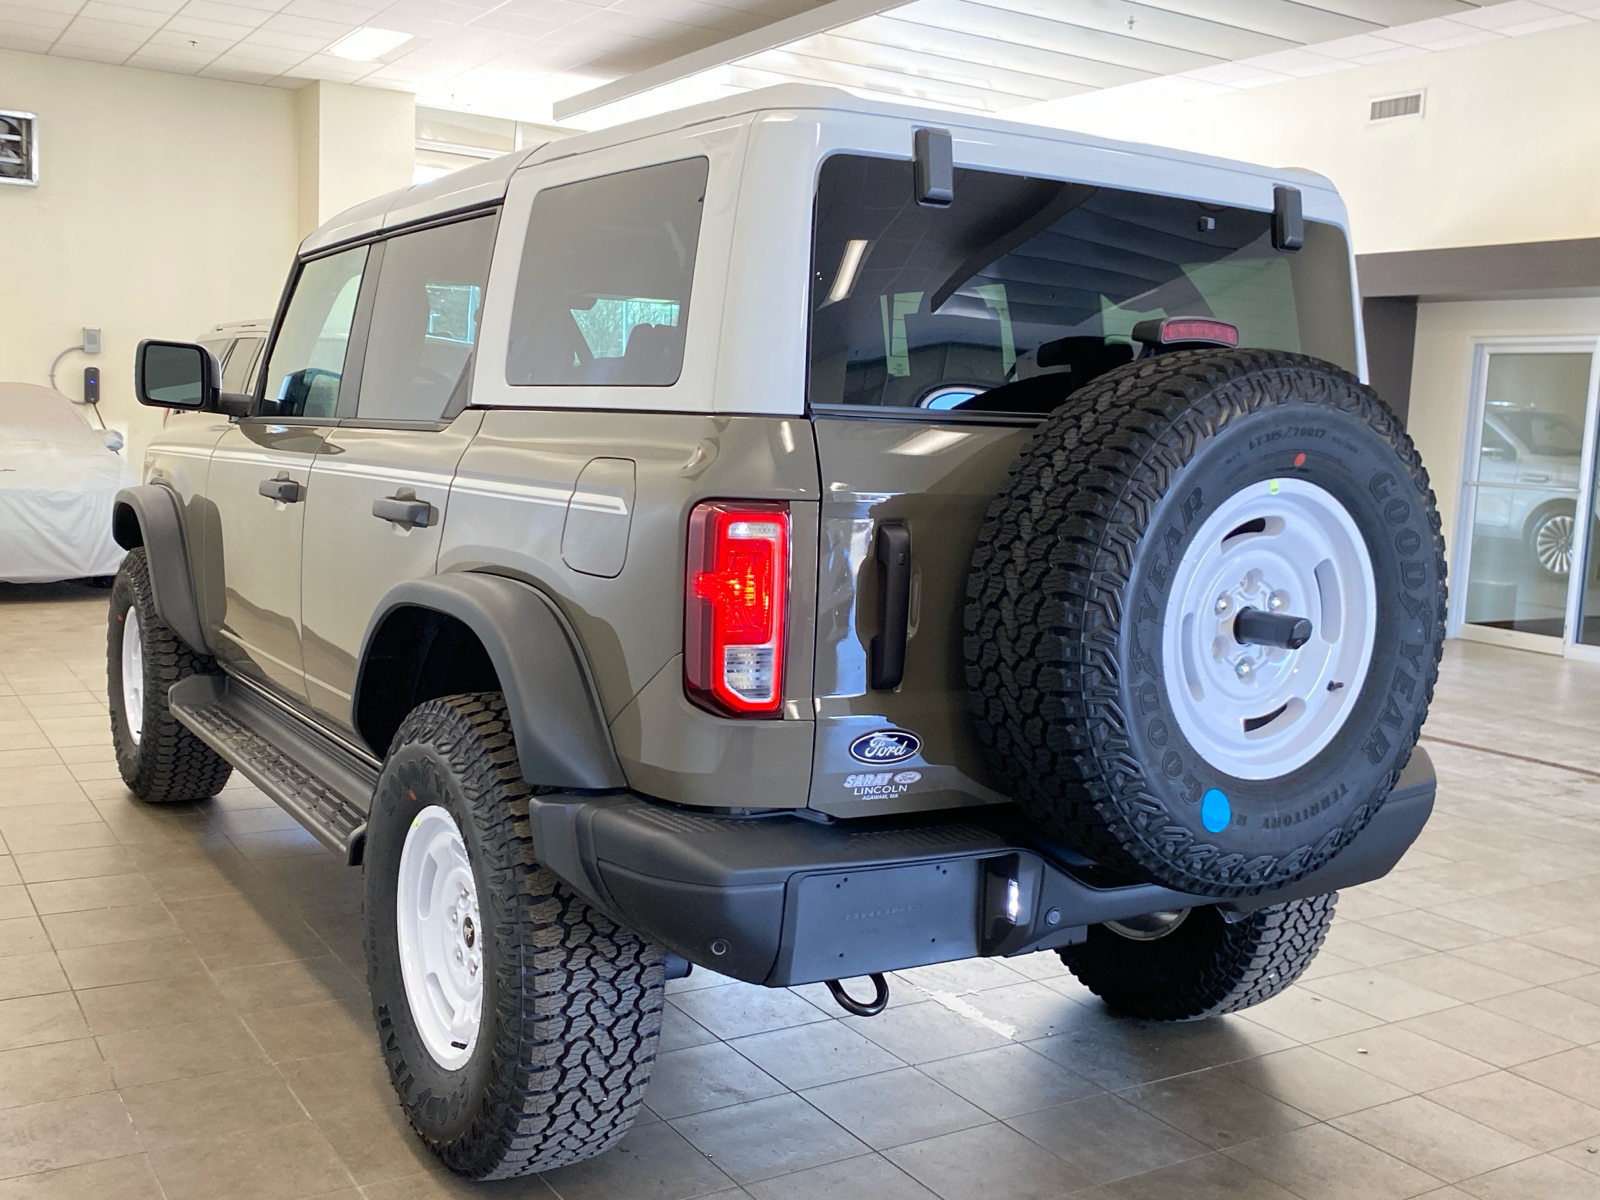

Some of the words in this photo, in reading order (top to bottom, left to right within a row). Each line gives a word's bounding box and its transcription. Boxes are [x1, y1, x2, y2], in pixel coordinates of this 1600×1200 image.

[1131, 486, 1204, 805] GOODYEAR
[1362, 471, 1432, 767] GOODYEAR
[844, 772, 894, 788] SARAT
[853, 784, 908, 796] LINCOLN
[1260, 782, 1350, 830] TERRITORY
[378, 1003, 469, 1126] GOODYEAR
